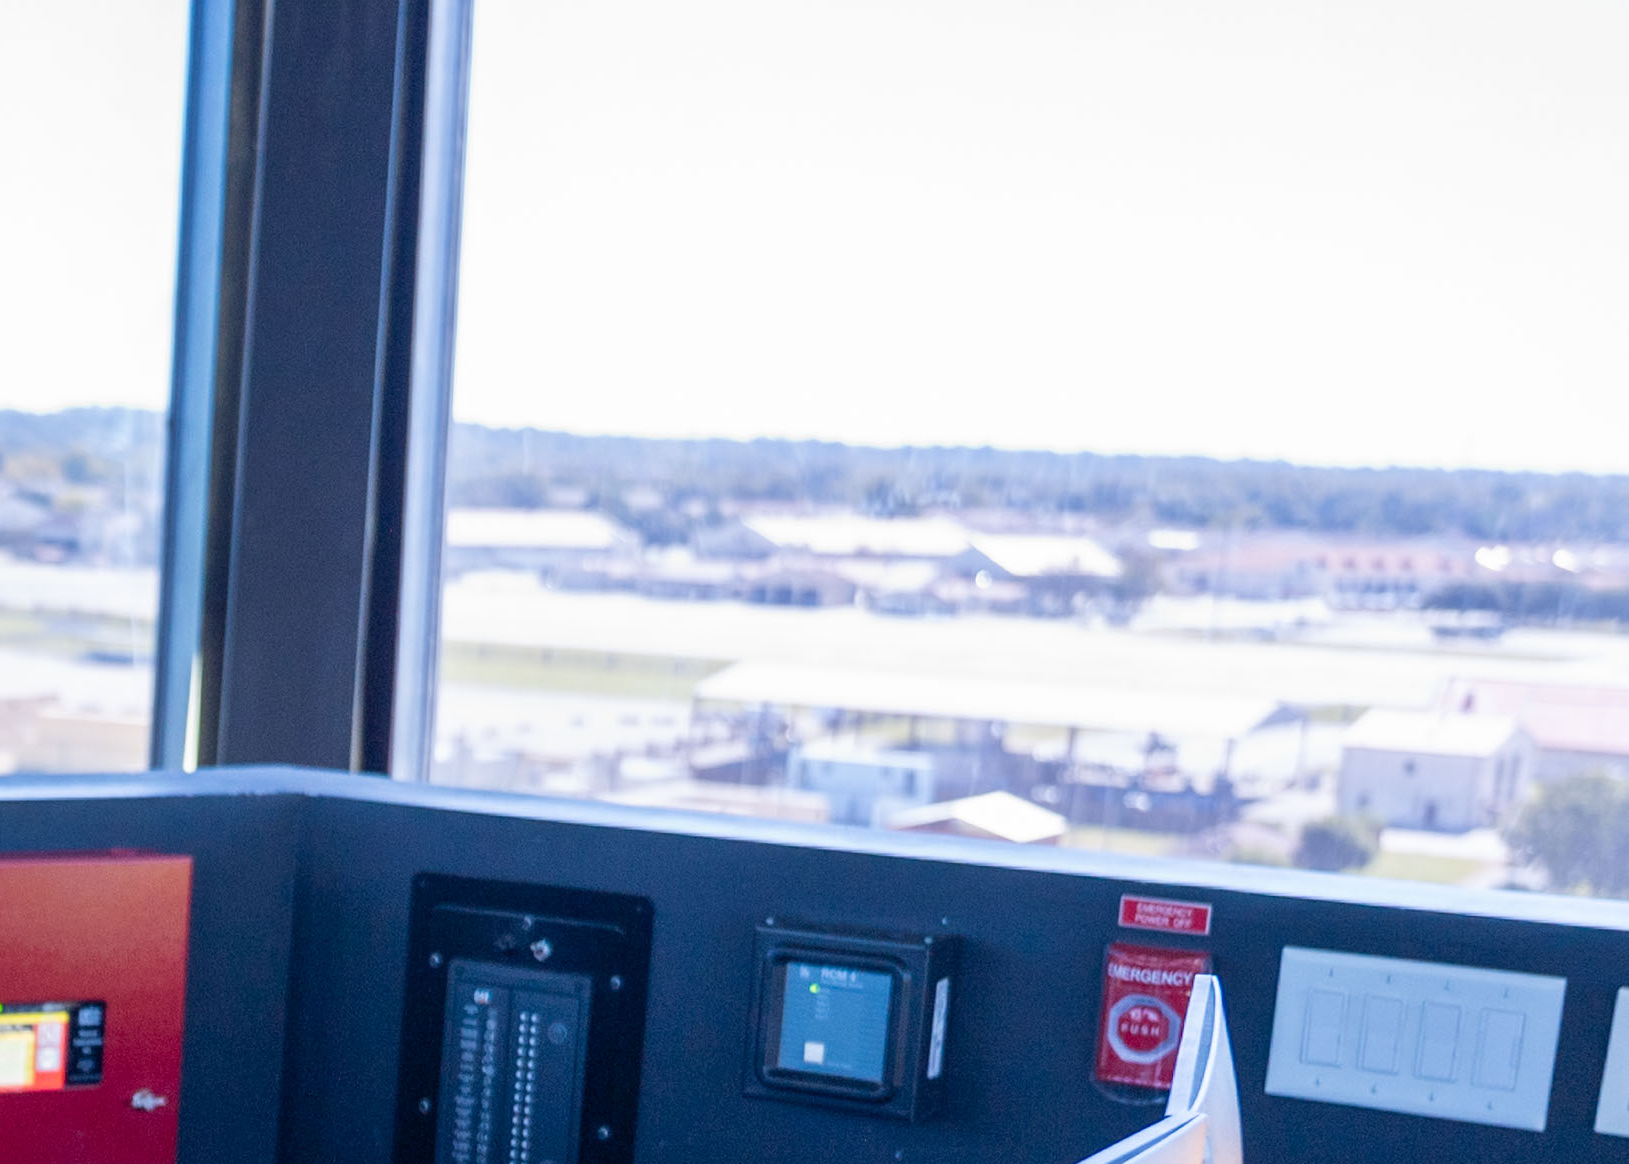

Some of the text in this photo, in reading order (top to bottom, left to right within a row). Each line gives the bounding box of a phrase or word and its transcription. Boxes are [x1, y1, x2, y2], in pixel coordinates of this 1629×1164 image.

[1136, 902, 1193, 919] EMERGENCY
[1135, 913, 1193, 929] POWER OFF
[1108, 962, 1193, 986] EMERGENCY
[1121, 1024, 1160, 1036] PUSH
